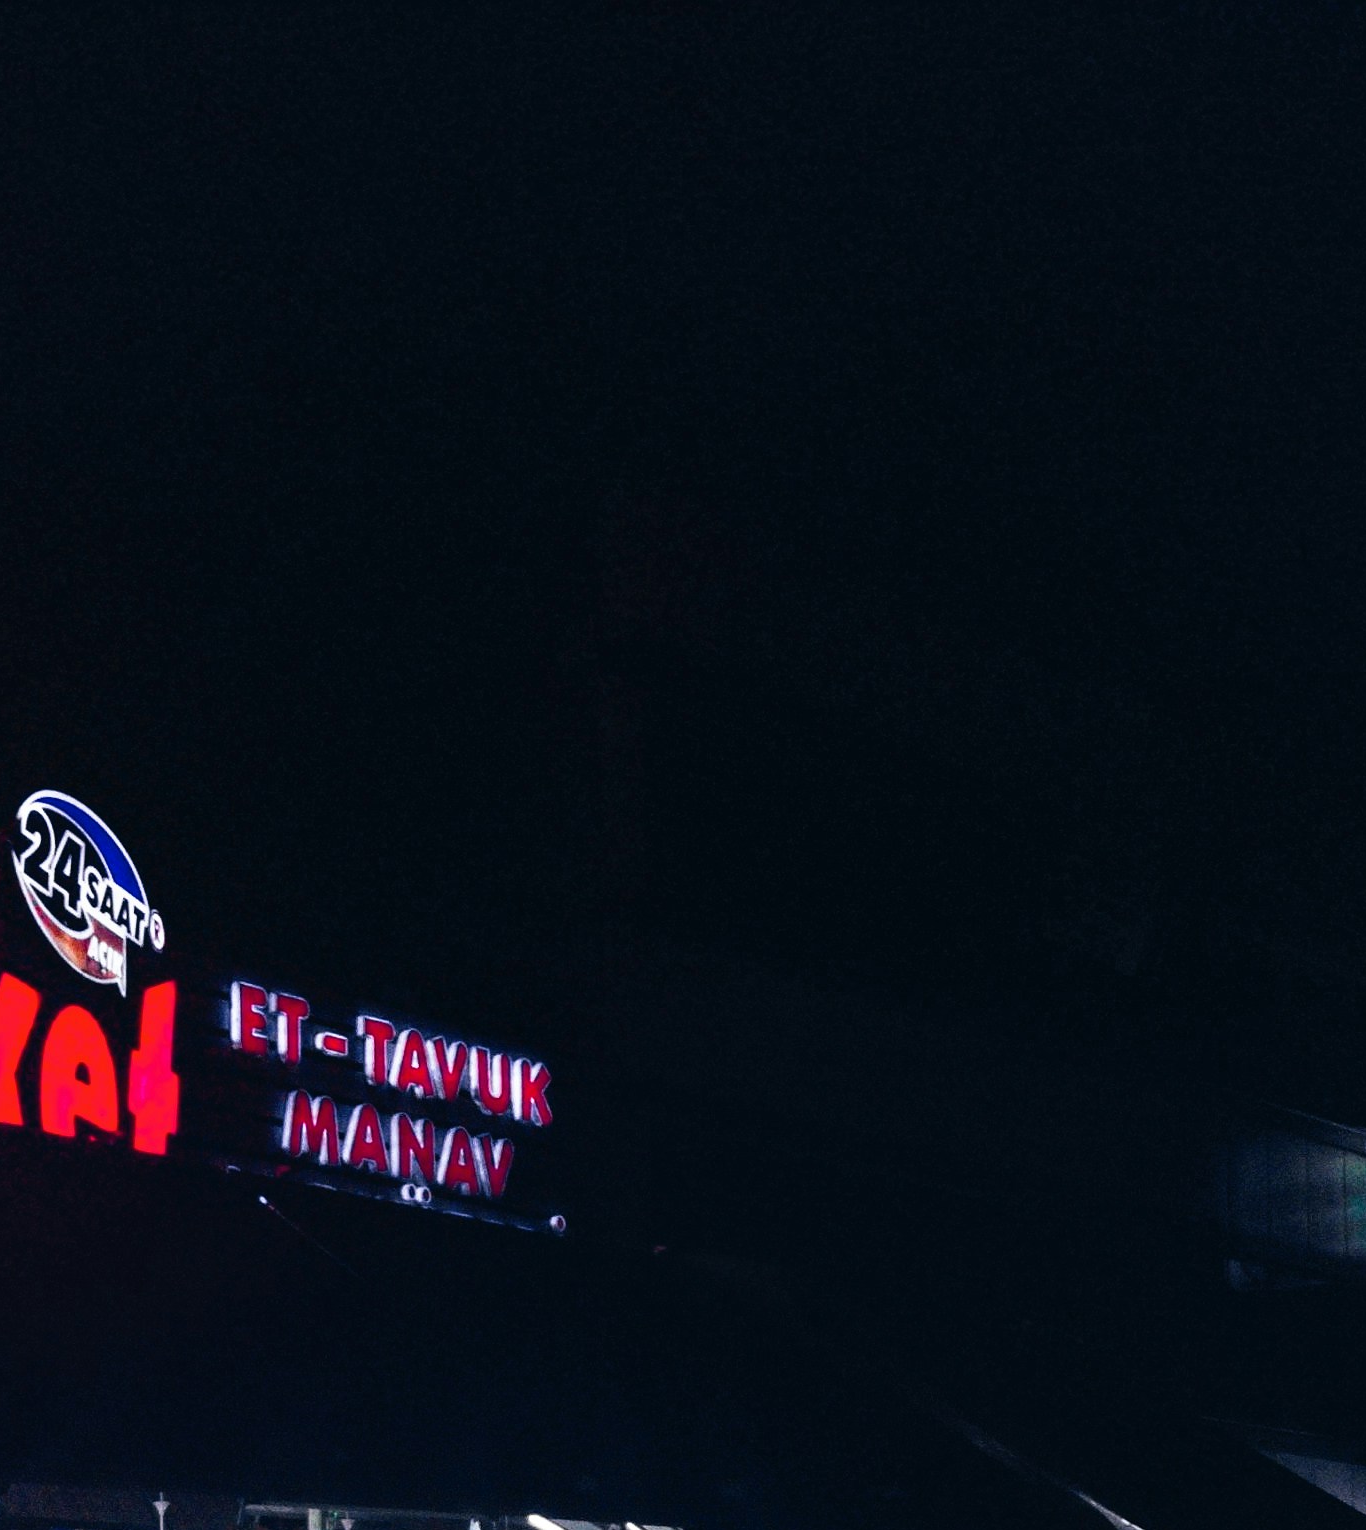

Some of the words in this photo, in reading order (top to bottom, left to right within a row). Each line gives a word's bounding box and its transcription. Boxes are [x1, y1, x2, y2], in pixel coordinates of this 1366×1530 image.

[21, 806, 85, 919] 24
[85, 867, 149, 947] SAAT
[230, 981, 310, 1066] ET
[354, 1015, 553, 1127] TAVUK
[281, 1088, 513, 1197] MANAV
